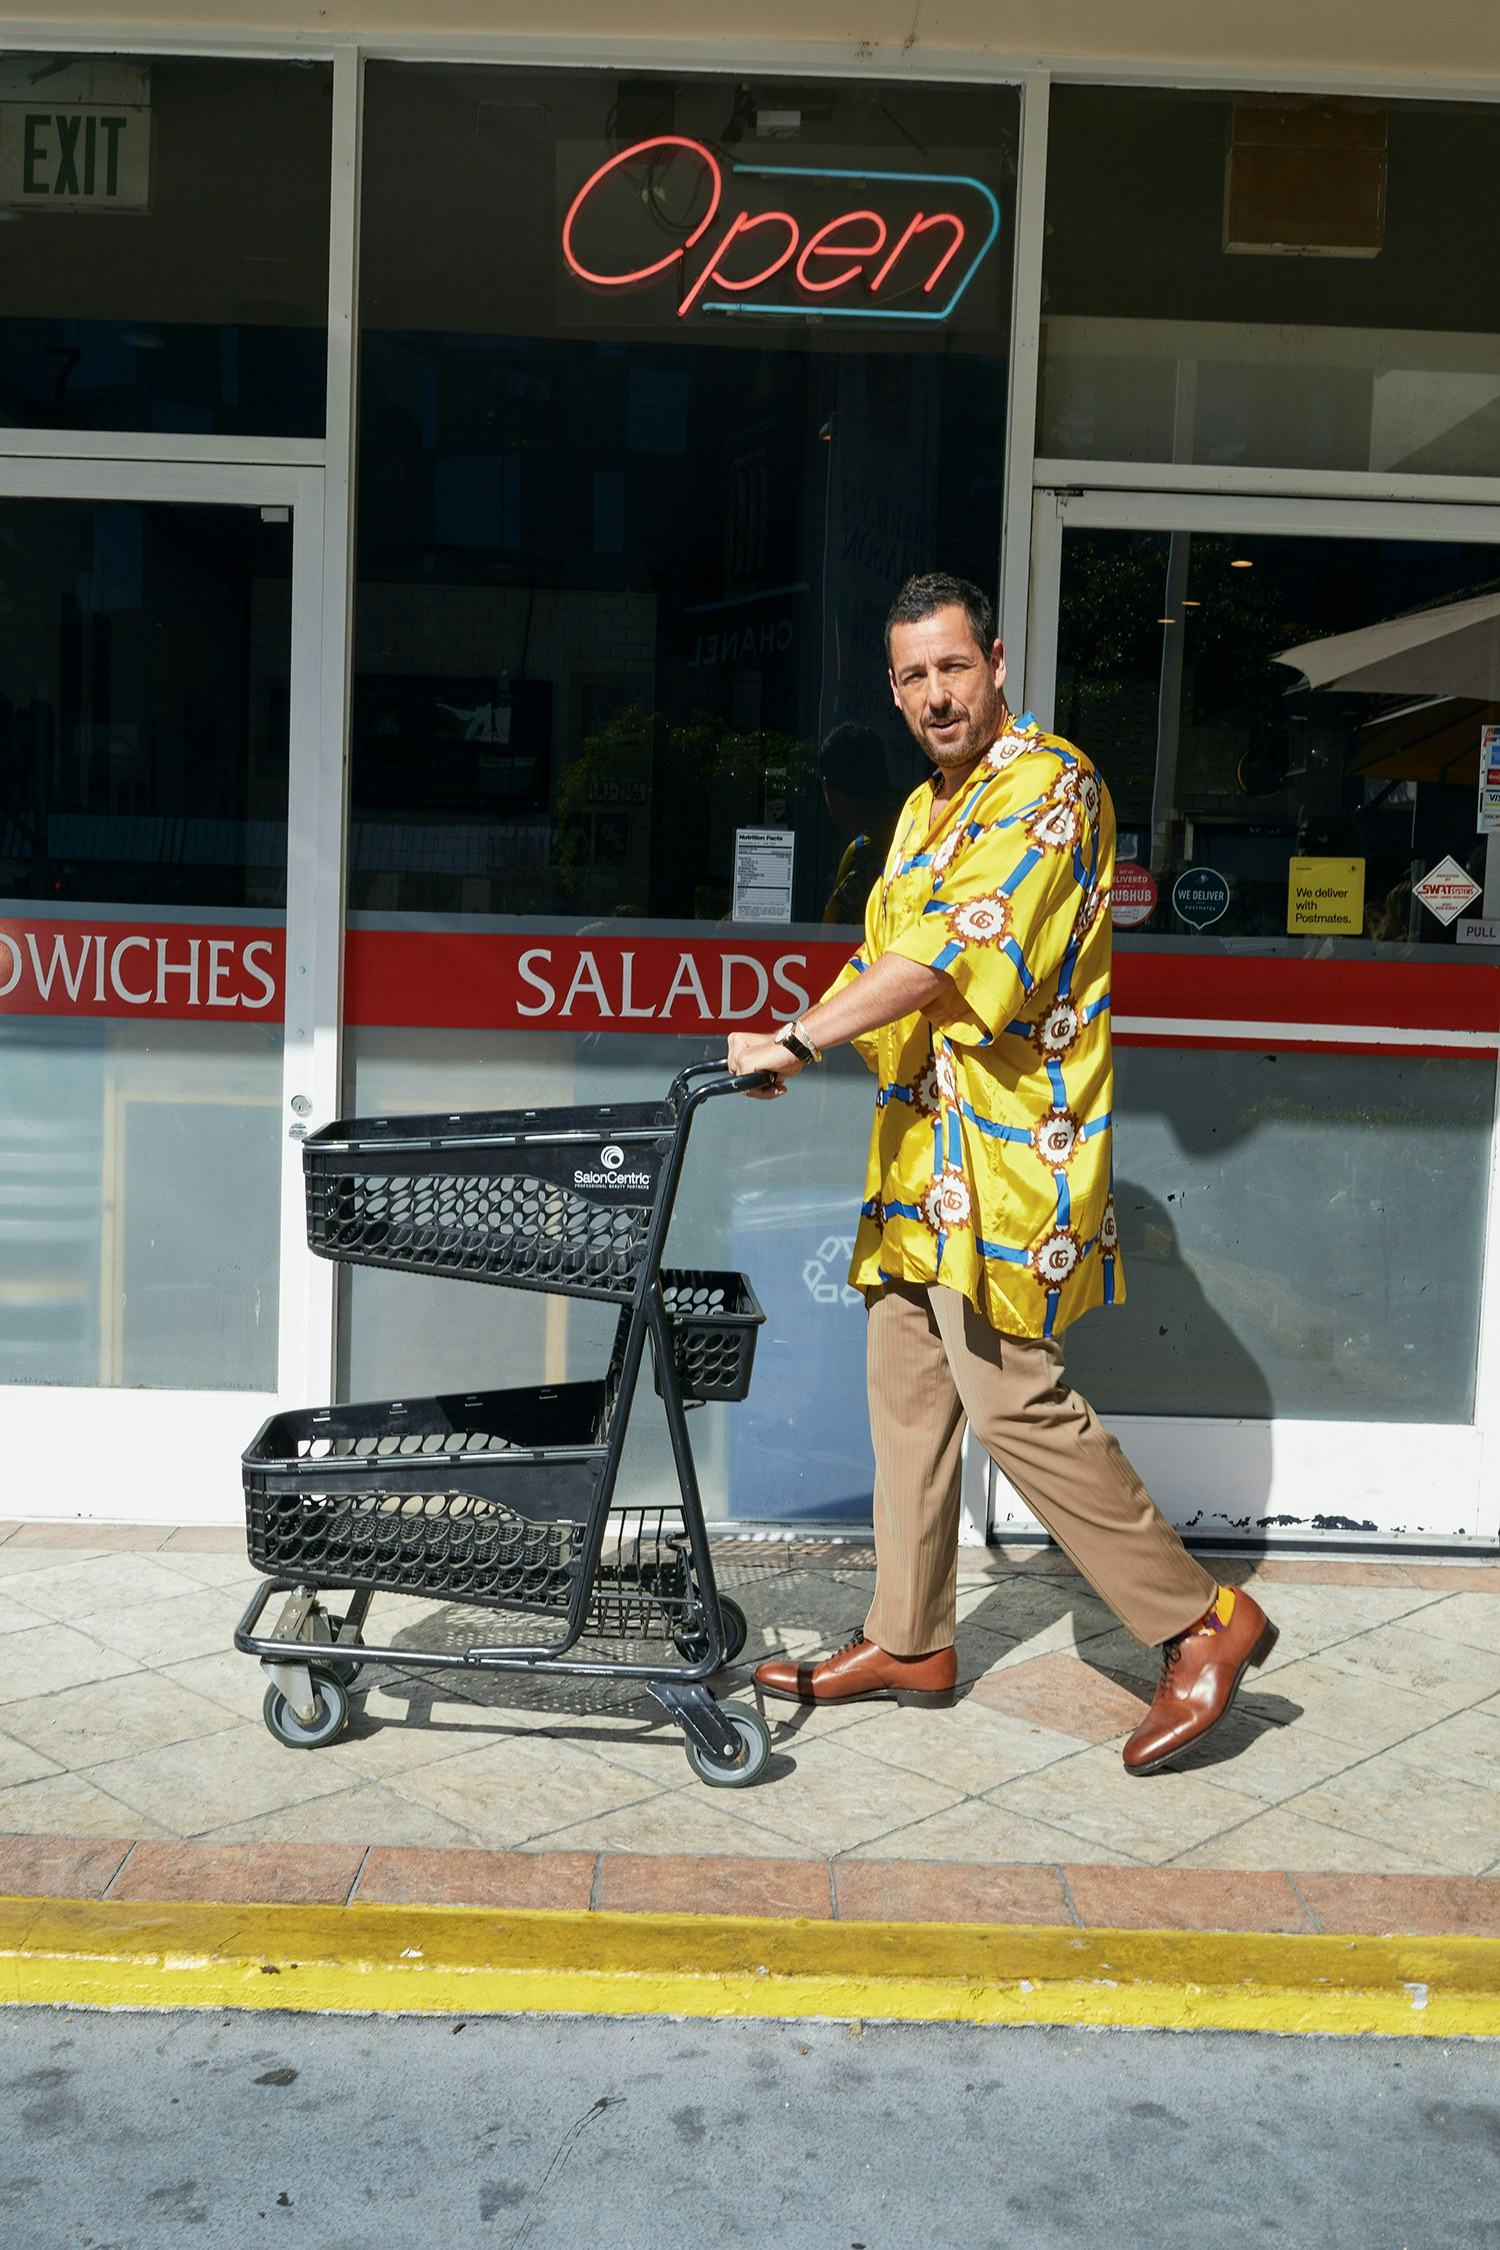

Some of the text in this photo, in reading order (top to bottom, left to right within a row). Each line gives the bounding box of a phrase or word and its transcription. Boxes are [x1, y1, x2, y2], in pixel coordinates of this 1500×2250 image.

[23, 114, 127, 196] EXIT
[562, 135, 965, 316] Open
[1489, 794, 1500, 802] VIS
[1112, 876, 1148, 884] LIVERED
[1110, 889, 1152, 902] RUBHUB
[1178, 889, 1225, 902] WE DELIVER
[1296, 887, 1349, 898] We deliver
[1295, 900, 1318, 911] with
[1295, 912, 1352, 924] Postmates.
[1466, 926, 1497, 938] PULL
[516, 948, 810, 1022] SALADS
[574, 1170, 651, 1185] SalonCentric
